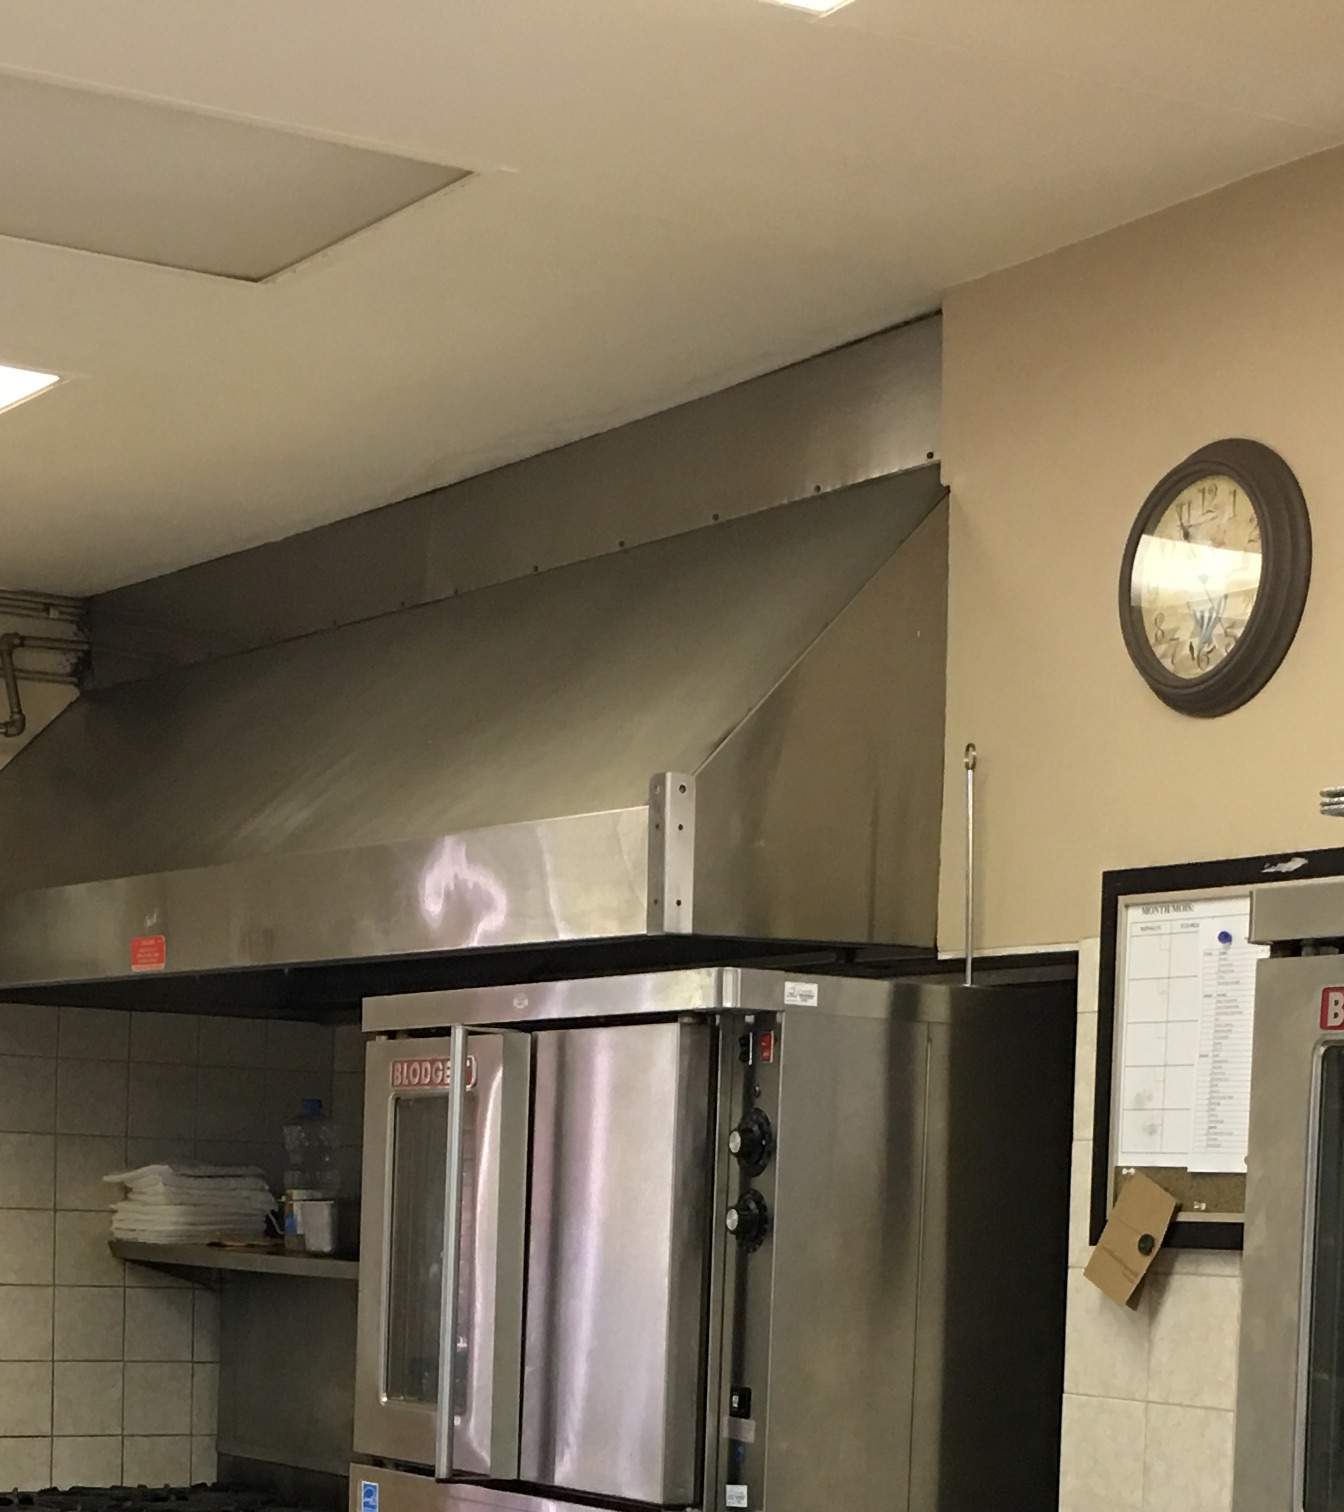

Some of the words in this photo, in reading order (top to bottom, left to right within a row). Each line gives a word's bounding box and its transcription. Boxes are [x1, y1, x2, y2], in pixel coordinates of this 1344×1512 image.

[1197, 484, 1218, 516] 12
[1154, 612, 1165, 643] 8
[393, 1060, 471, 1086] BLODGE
